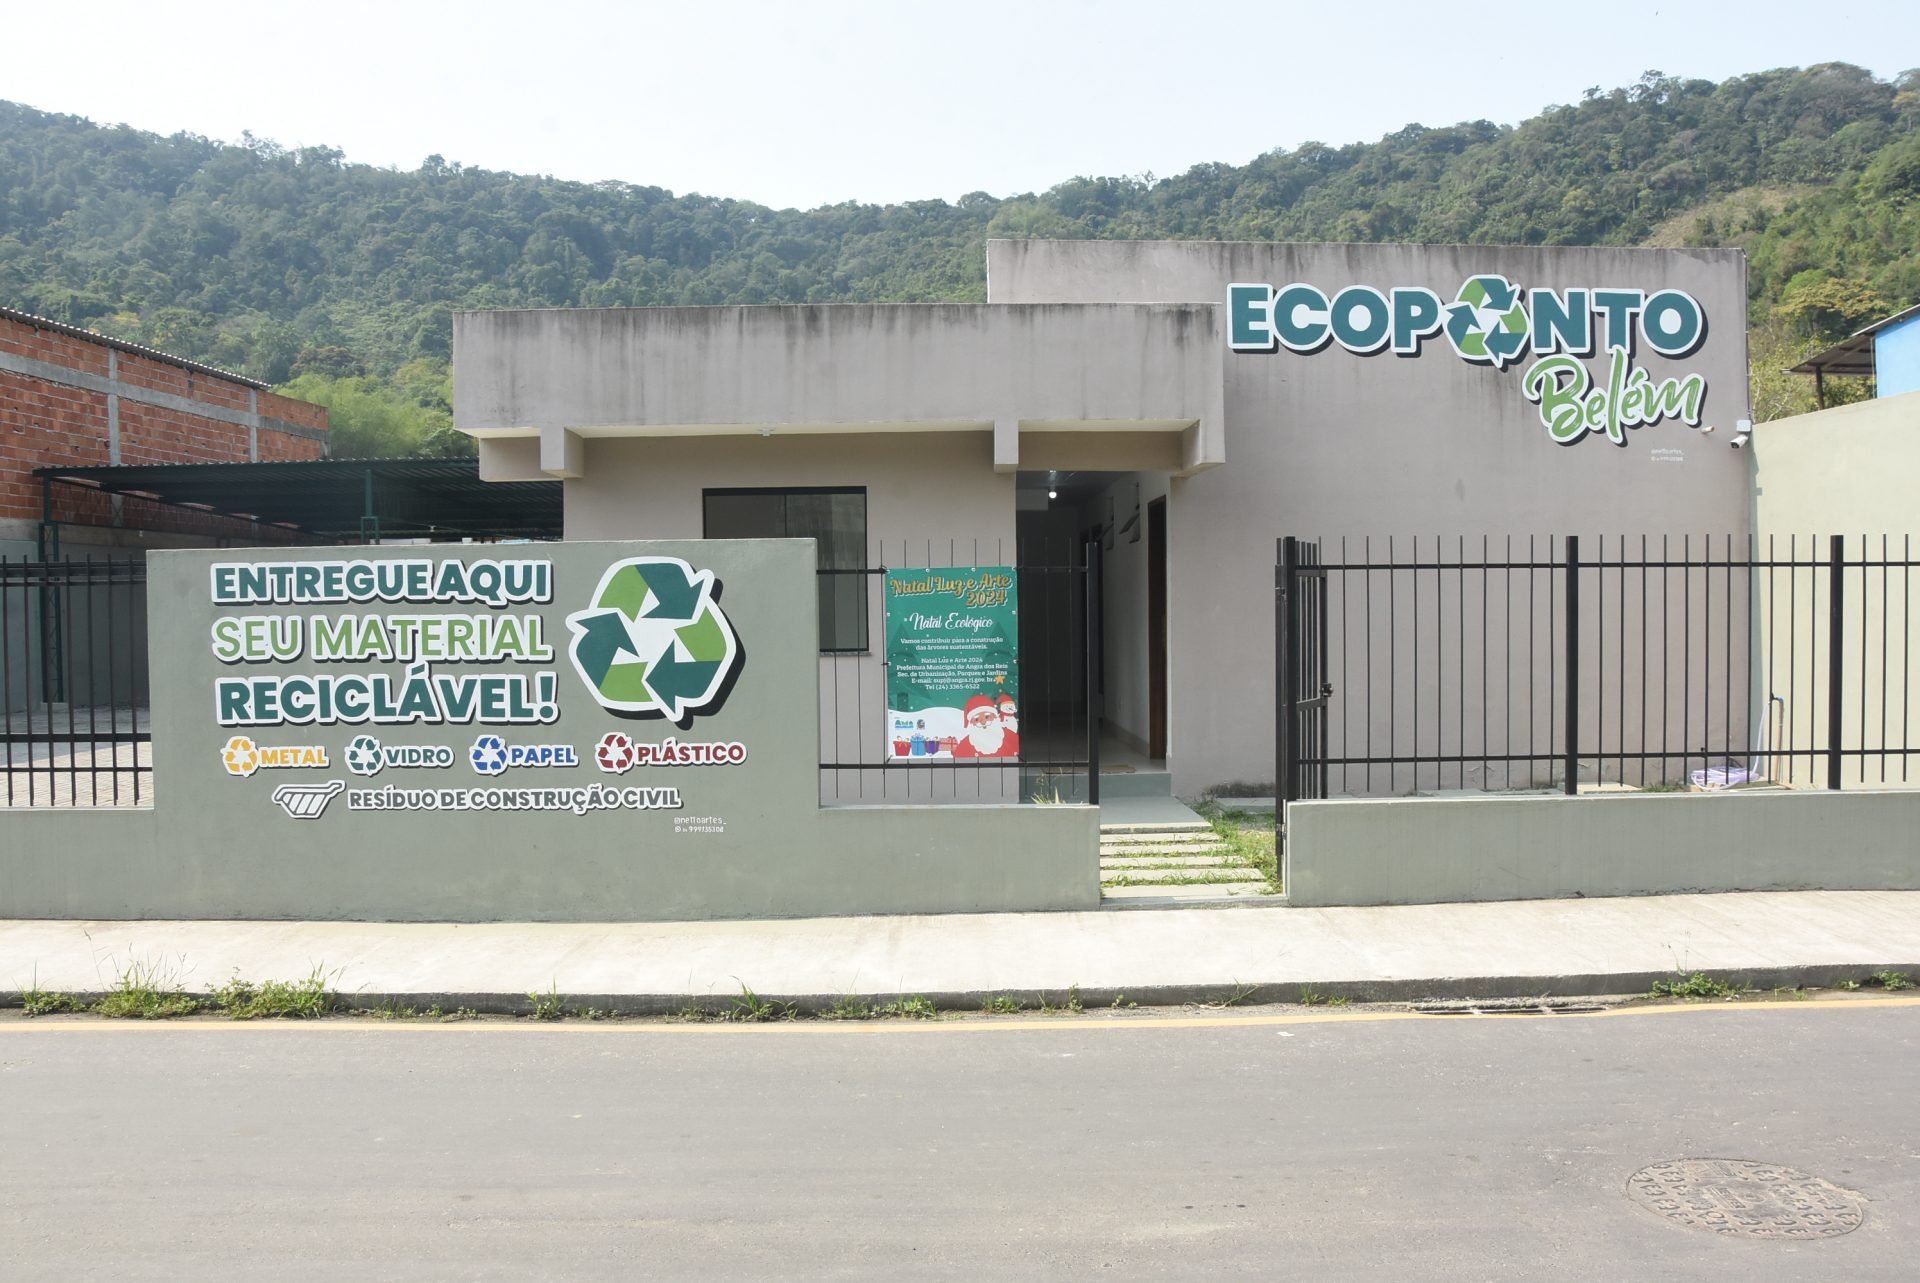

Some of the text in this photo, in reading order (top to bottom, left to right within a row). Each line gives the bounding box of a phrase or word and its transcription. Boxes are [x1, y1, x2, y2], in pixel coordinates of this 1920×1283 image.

[1525, 348, 1704, 443] Belém
[213, 561, 549, 603] ENTREGUE AQUI
[890, 573, 1013, 598] Natal Luz e Arte
[965, 588, 1008, 608] 2024
[909, 611, 994, 633] Natal Ecológico
[213, 617, 551, 659] SEU MATERIAL
[951, 638, 965, 646] para
[970, 636, 1004, 645] construção
[957, 670, 981, 678] Parques
[217, 662, 557, 722] RECICLÁVEL!
[259, 747, 329, 767] METAL
[384, 747, 452, 766] VIDRO
[510, 746, 576, 765] PAPEL
[636, 740, 745, 763] PLÁSTICO
[349, 784, 681, 813] RESÍDUO DE CONSTRUÇÃO CIVIL
